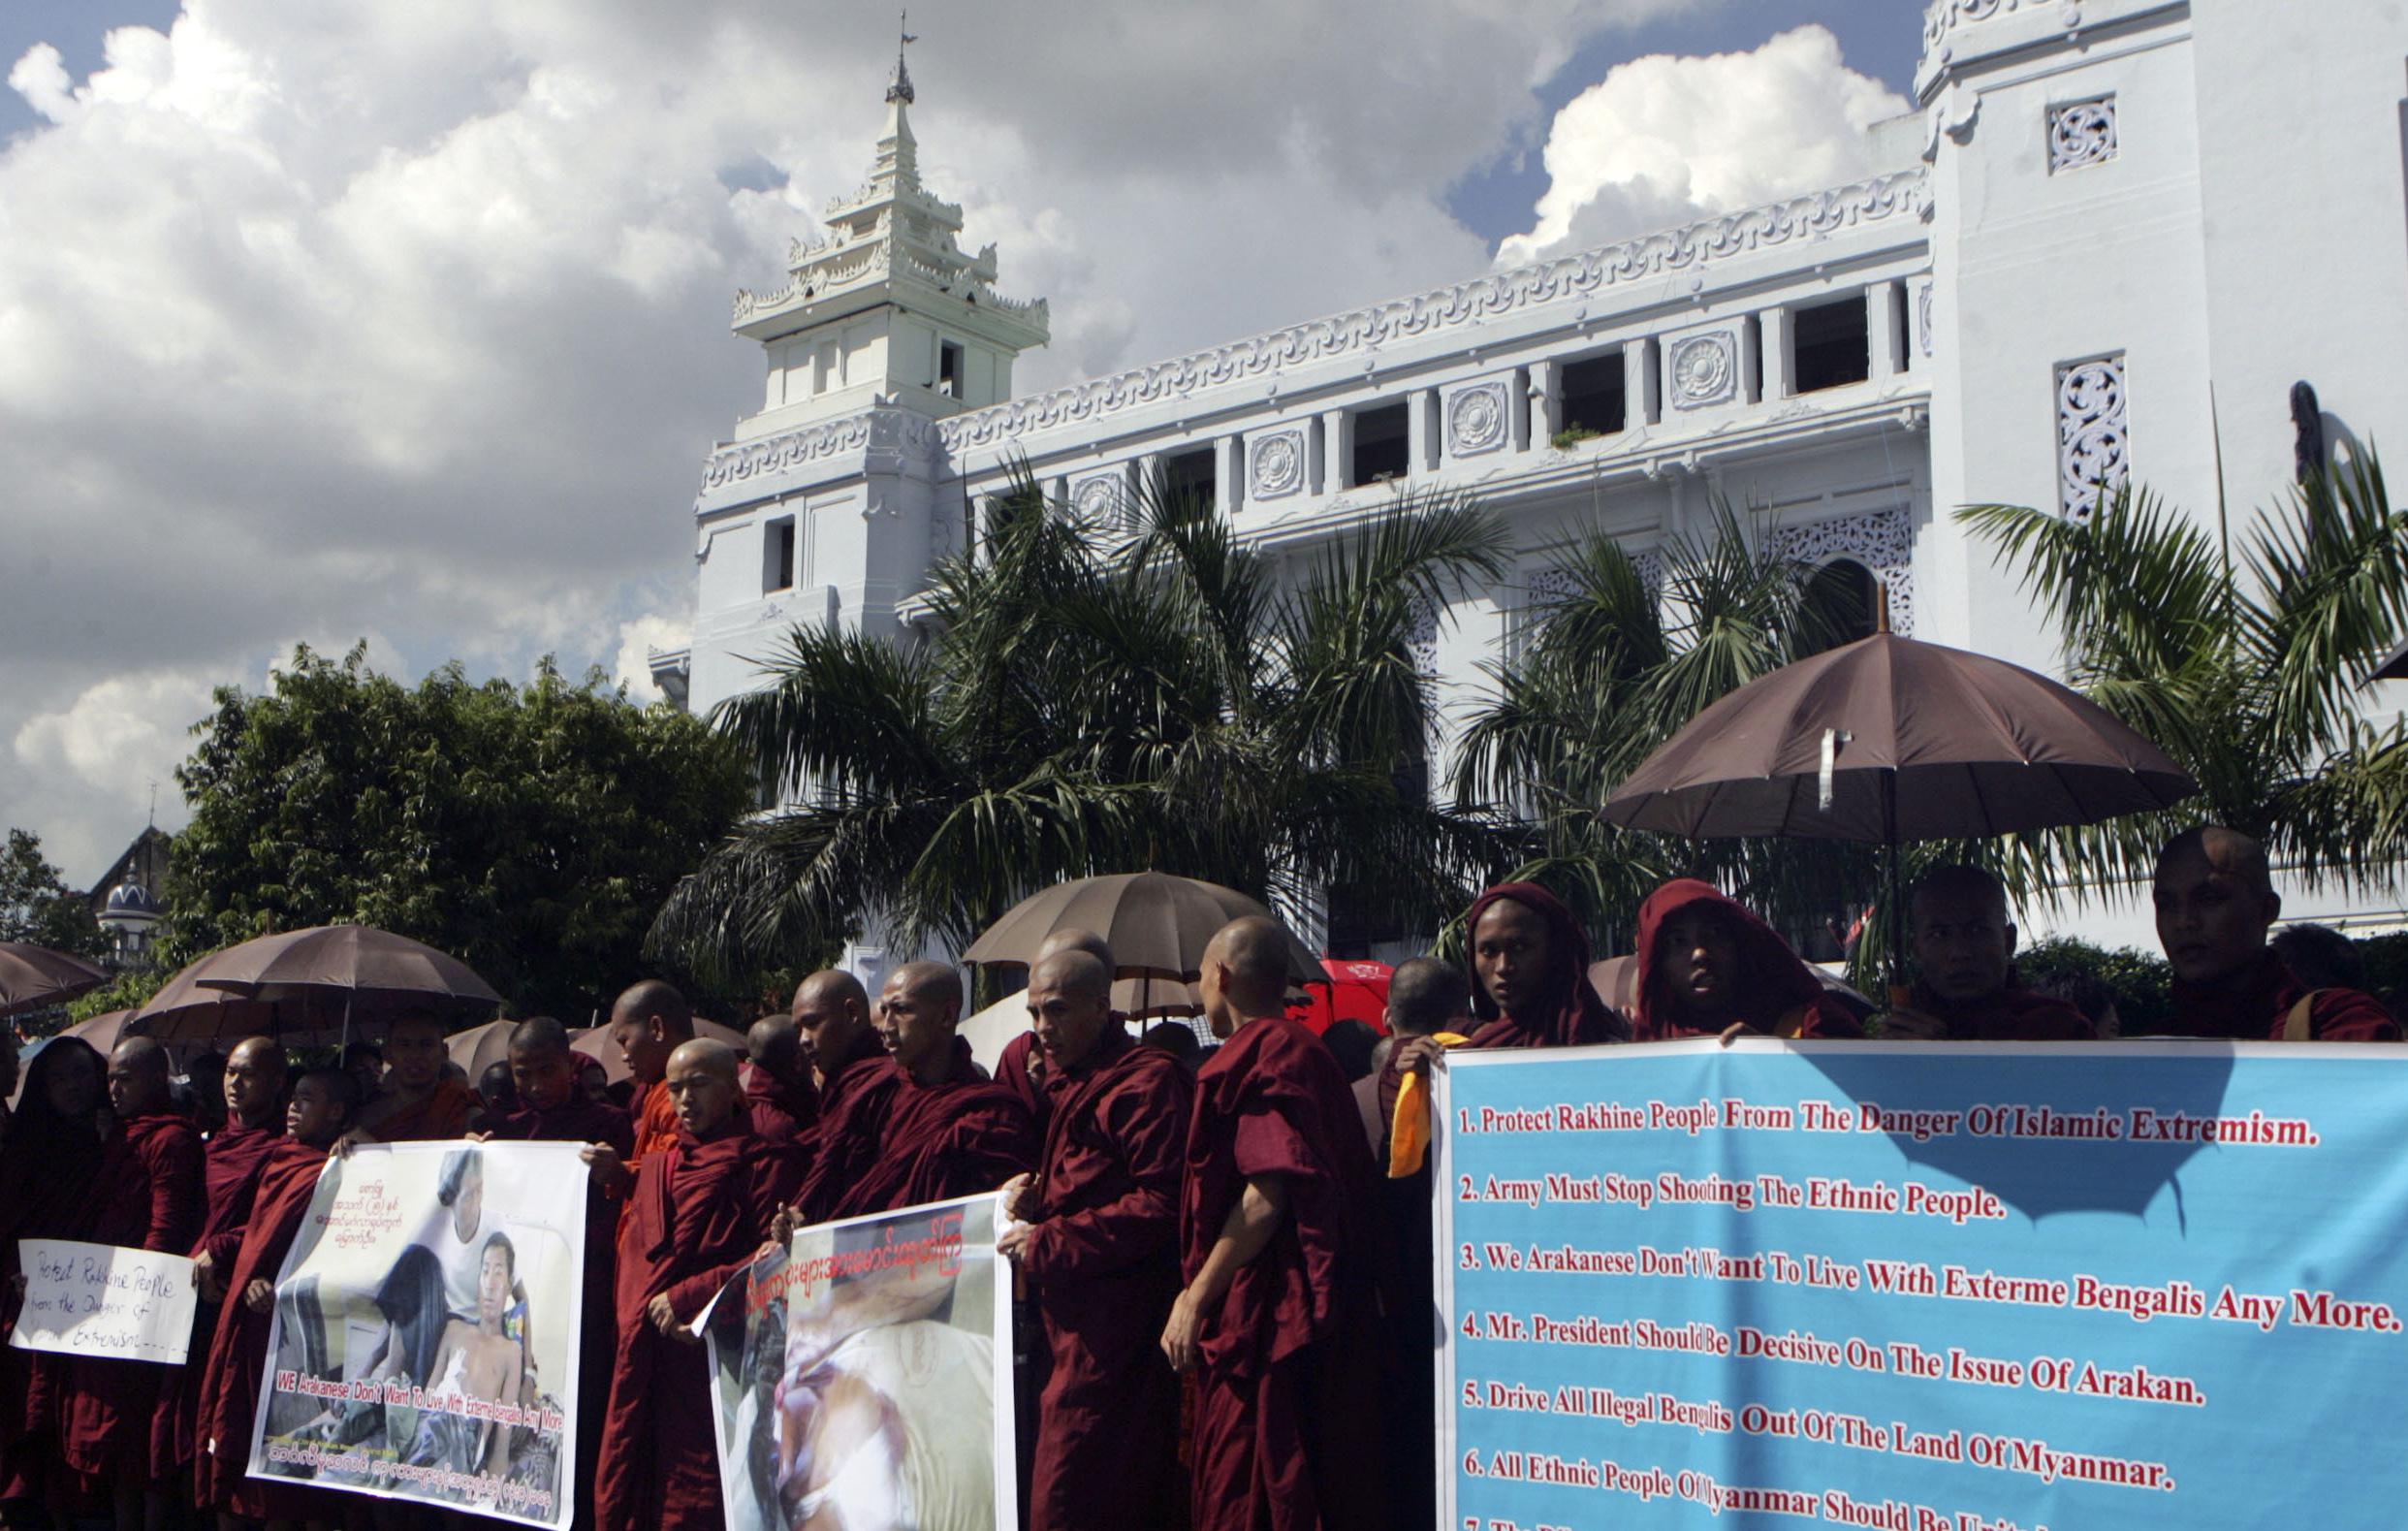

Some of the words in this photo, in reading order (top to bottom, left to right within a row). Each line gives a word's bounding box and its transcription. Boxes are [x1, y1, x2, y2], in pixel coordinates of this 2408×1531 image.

[1461, 1110, 1476, 1132] 1.
[1482, 1108, 1552, 1132] Protect
[1558, 1105, 1644, 1131] Rakhine
[1650, 1101, 1717, 1134] People
[1725, 1100, 1791, 1129] From
[1801, 1102, 1852, 1132] The
[1859, 1104, 1958, 1138] Danger
[1970, 1108, 2005, 1134] Of
[2016, 1108, 2119, 1138] Islamic
[2132, 1111, 2318, 1145] Extremism.
[1461, 1176, 1478, 1200] 2.
[1486, 1179, 1541, 1206] Army
[1548, 1175, 1600, 1201] Must
[1605, 1176, 1654, 1208] Stop
[1660, 1175, 1754, 1209] Shooting
[1759, 1177, 1802, 1206] The
[1809, 1180, 1897, 1212] Ethnic
[1906, 1183, 2006, 1224] People.
[59, 1292, 74, 1313] the
[1462, 1244, 1480, 1268] 3.
[1486, 1245, 1520, 1269] We
[1529, 1247, 1634, 1273] Arakanese
[1641, 1248, 1697, 1275] Don't
[1701, 1250, 1763, 1279] Want
[1771, 1255, 1801, 1282] To
[1808, 1258, 1859, 1289] Live
[1867, 1261, 1935, 1294] With
[1944, 1267, 2067, 1306] Exterme
[2075, 1276, 2203, 1321] Bengalis
[2212, 1289, 2284, 1330] Any
[2292, 1292, 2401, 1331] More.
[1463, 1314, 1481, 1337] 4.
[1489, 1314, 1527, 1340] Mr.
[1535, 1316, 1630, 1345] President
[1738, 1329, 1840, 1365] Decisive
[1847, 1340, 1885, 1370] On
[1890, 1345, 1942, 1377] The
[1950, 1351, 2023, 1387] Issue
[2031, 1358, 2073, 1390] Of
[2076, 1364, 2203, 1405] Arakan.
[277, 1371, 296, 1390] WE
[300, 1377, 349, 1398] Arakanese
[354, 1381, 382, 1402] Don't
[385, 1386, 409, 1406] Want
[414, 1388, 424, 1407] To
[427, 1390, 443, 1409] Live
[448, 1393, 463, 1413] With
[524, 1405, 540, 1431] Any
[543, 1408, 563, 1429] More
[1465, 1382, 1482, 1406] 5.
[1490, 1384, 1547, 1411] Drive
[1556, 1389, 1585, 1414] All
[1592, 1390, 1655, 1425] Illegal
[1742, 1407, 1797, 1435] Out
[1804, 1411, 1840, 1442] Of
[1840, 1417, 1887, 1450] The
[1893, 1424, 1961, 1461] Land
[1969, 1436, 2009, 1467] Of
[2012, 1441, 2173, 1489] Myanmar.
[1465, 1451, 1484, 1474] 6.
[1490, 1453, 1522, 1478] All
[1529, 1455, 1598, 1485] Ethnic
[1605, 1463, 1672, 1500] People
[1825, 1492, 1911, 1531] Should
